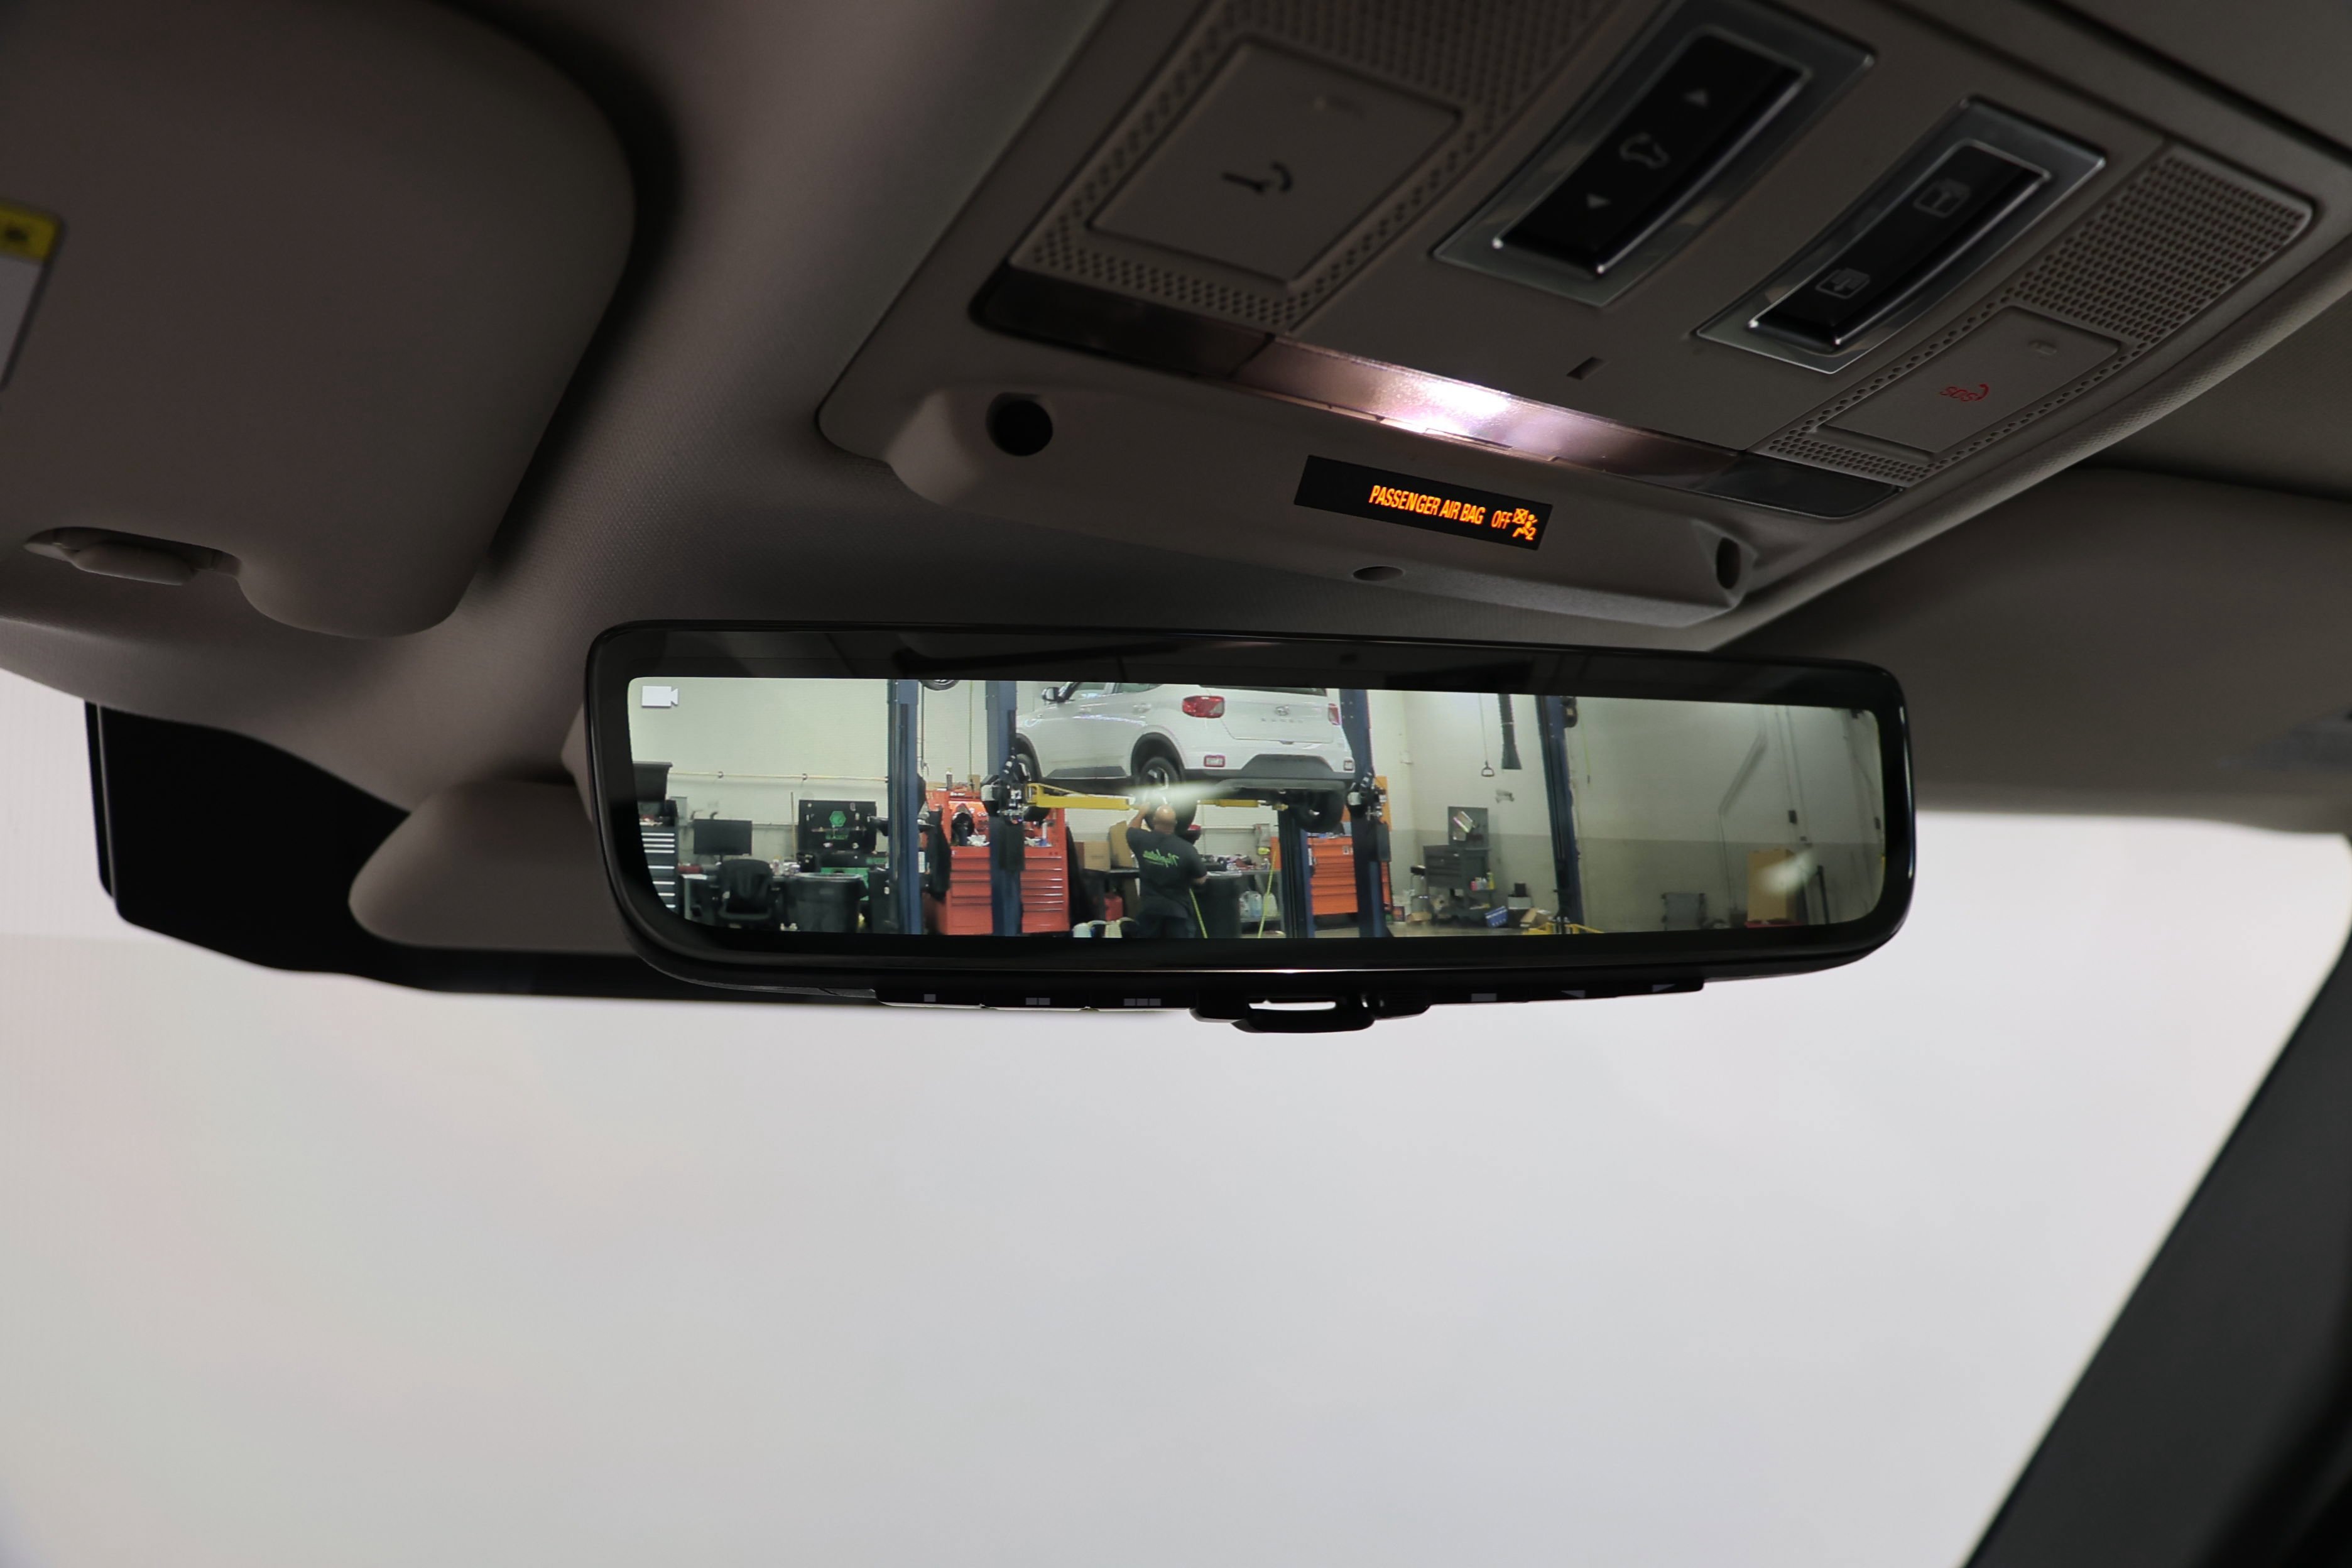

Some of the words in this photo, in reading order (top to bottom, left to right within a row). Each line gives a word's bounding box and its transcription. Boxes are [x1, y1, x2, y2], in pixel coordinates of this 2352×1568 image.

[1369, 485, 1441, 515] PASSENGER
[1439, 499, 1461, 520] AIR
[1460, 503, 1486, 525] BAG
[1491, 510, 1513, 529] OFF
